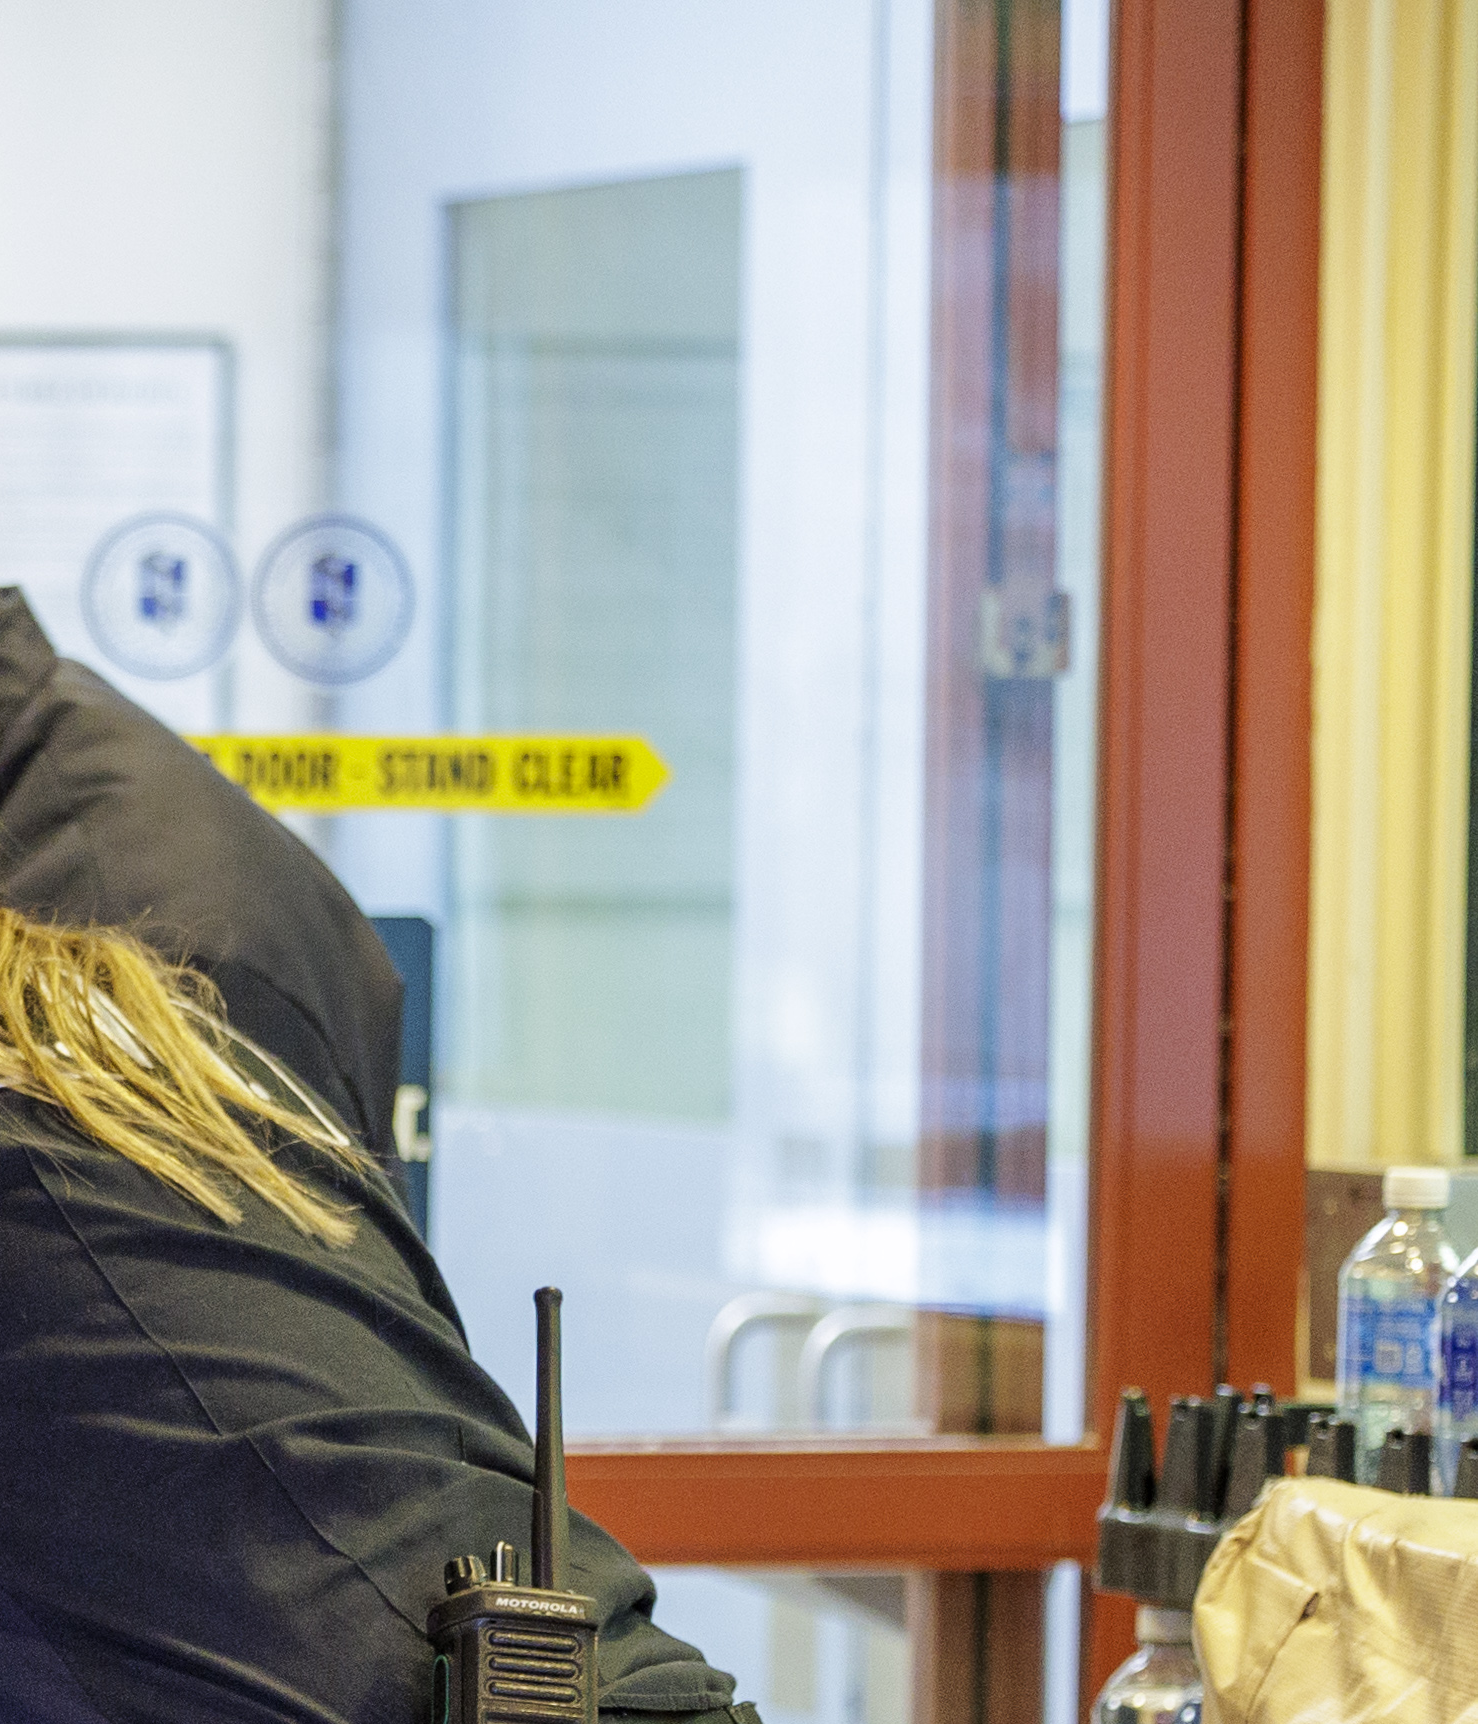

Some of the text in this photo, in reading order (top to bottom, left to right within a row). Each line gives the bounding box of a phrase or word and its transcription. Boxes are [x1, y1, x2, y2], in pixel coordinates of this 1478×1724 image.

[378, 748, 495, 797] STAND
[513, 749, 631, 799] CLEAR
[495, 1597, 578, 1616] MOTOROLA
